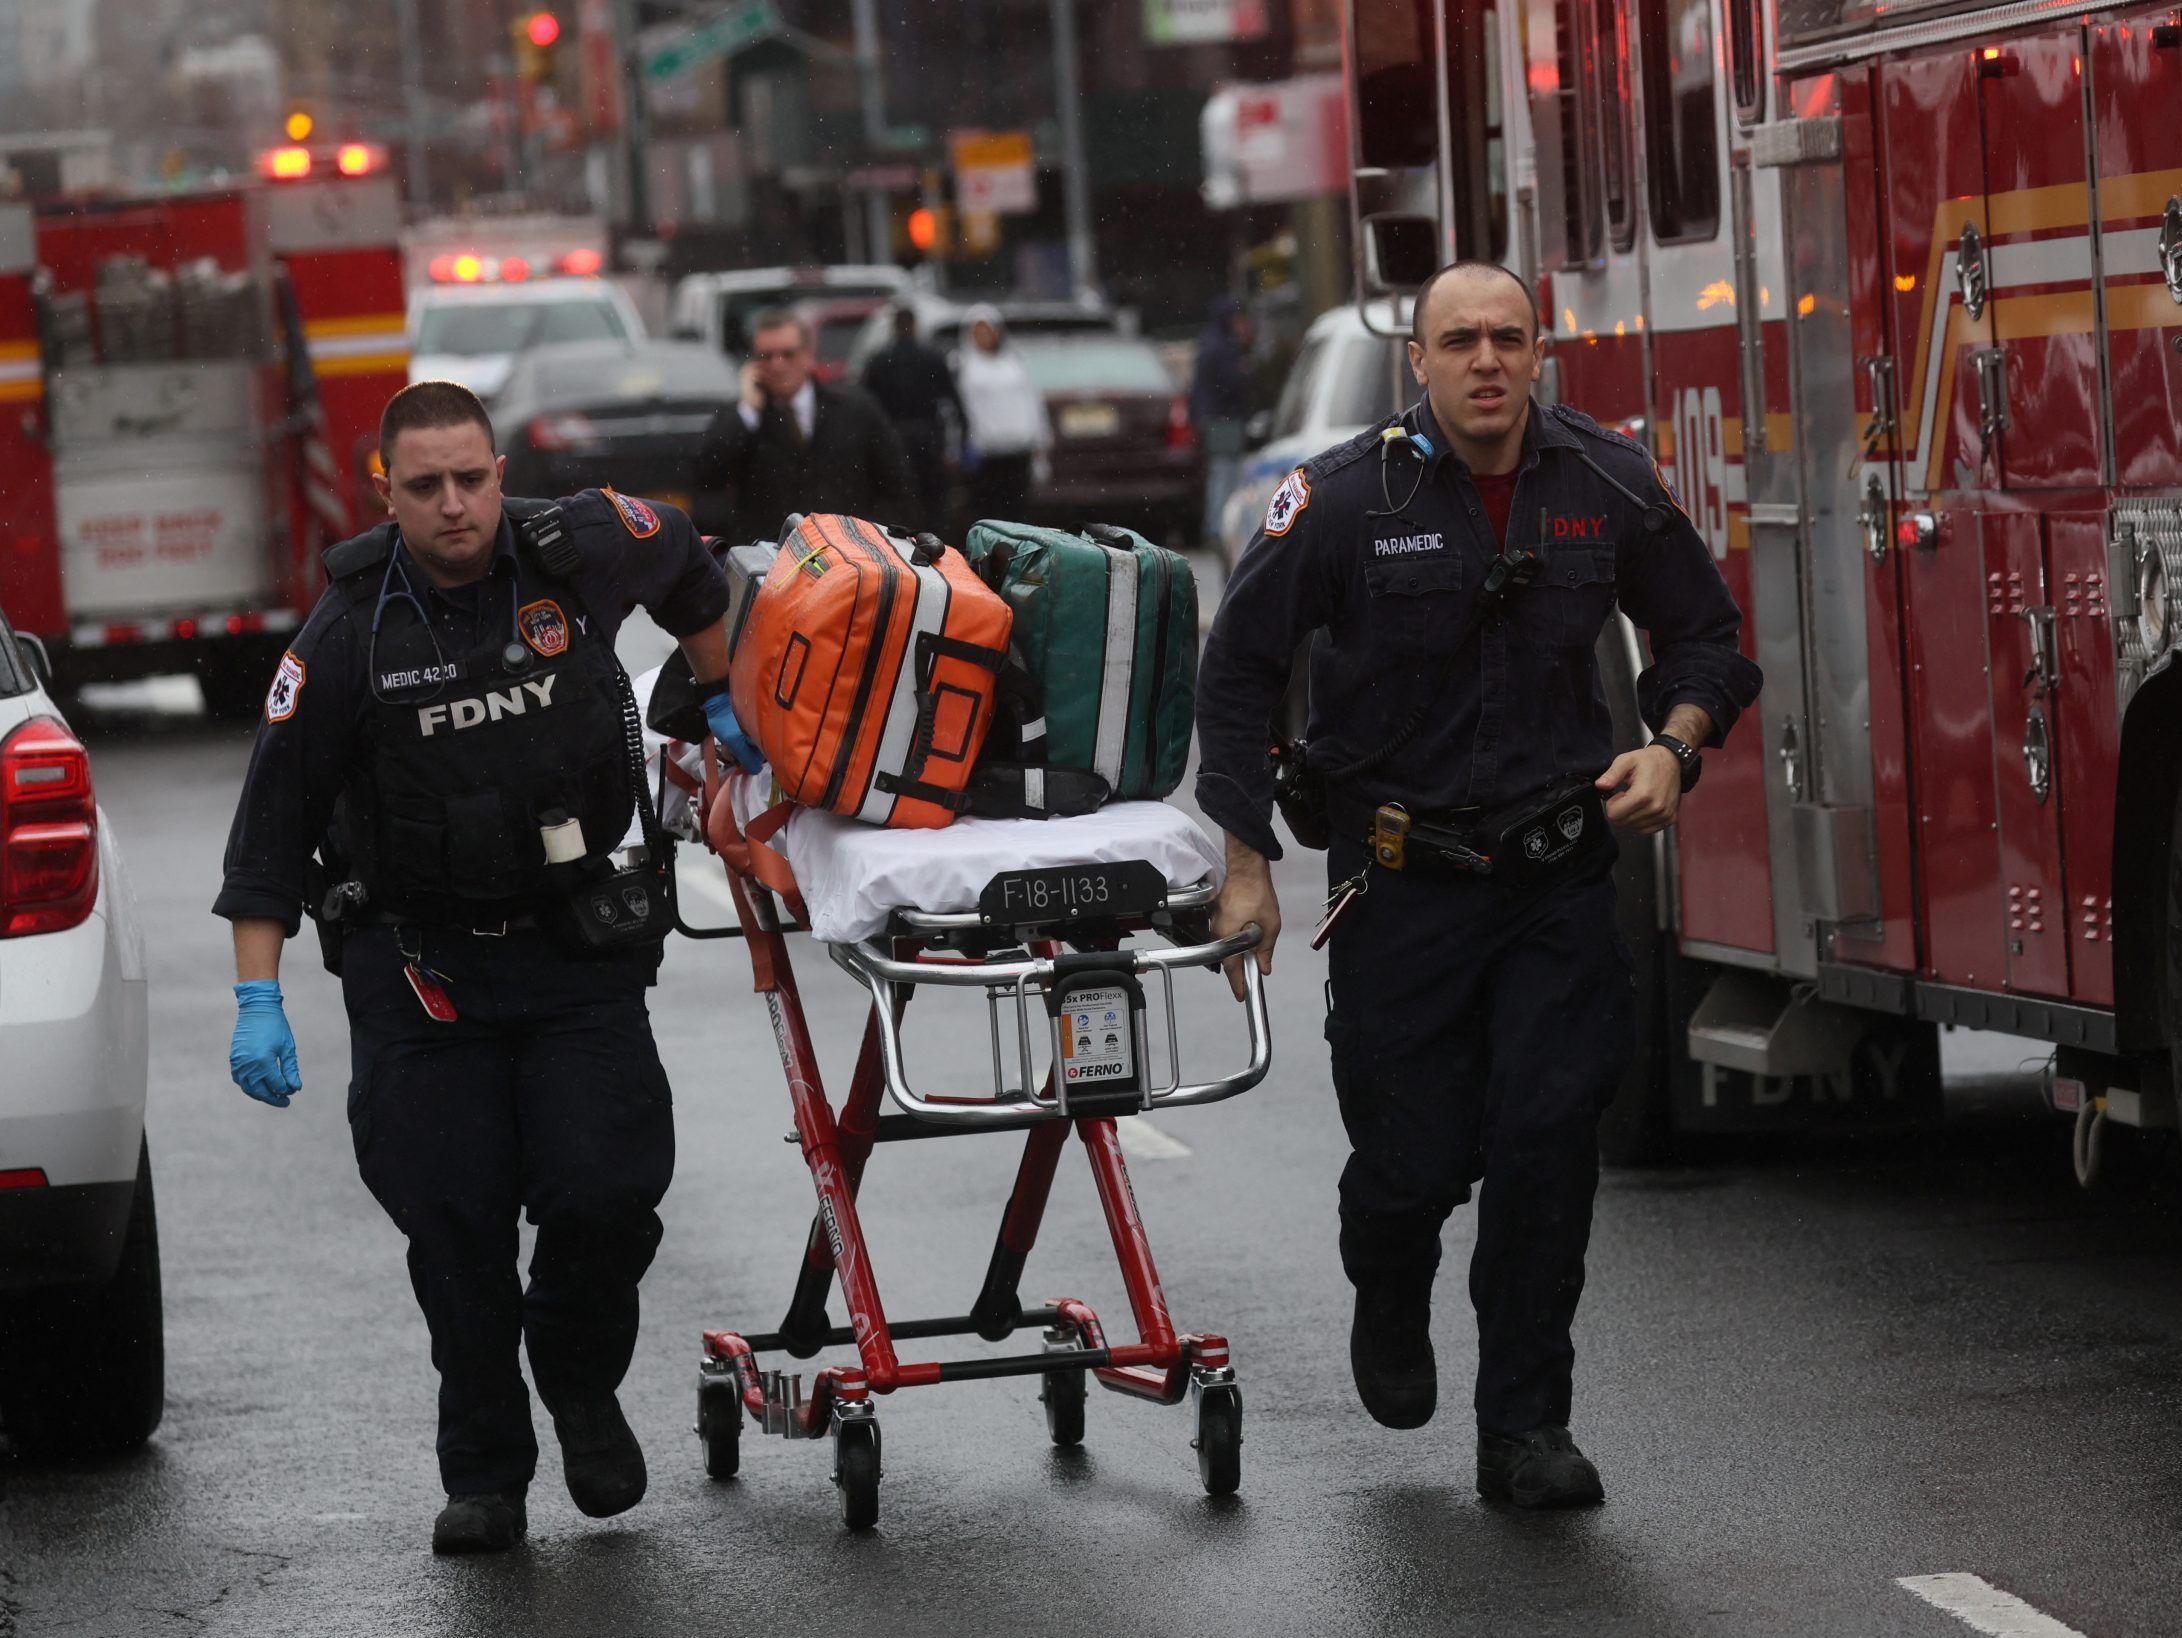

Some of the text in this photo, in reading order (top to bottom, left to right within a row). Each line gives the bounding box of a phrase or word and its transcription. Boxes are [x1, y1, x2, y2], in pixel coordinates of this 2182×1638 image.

[1673, 386, 1729, 561] 109
[1538, 517, 1604, 538] DNY
[1375, 533, 1444, 556] PARAMEDIC
[381, 670, 420, 690] MEDIC
[418, 673, 556, 737] FDNY
[1079, 1063, 1123, 1078] FERNO
[820, 1194, 844, 1257] FERNO
